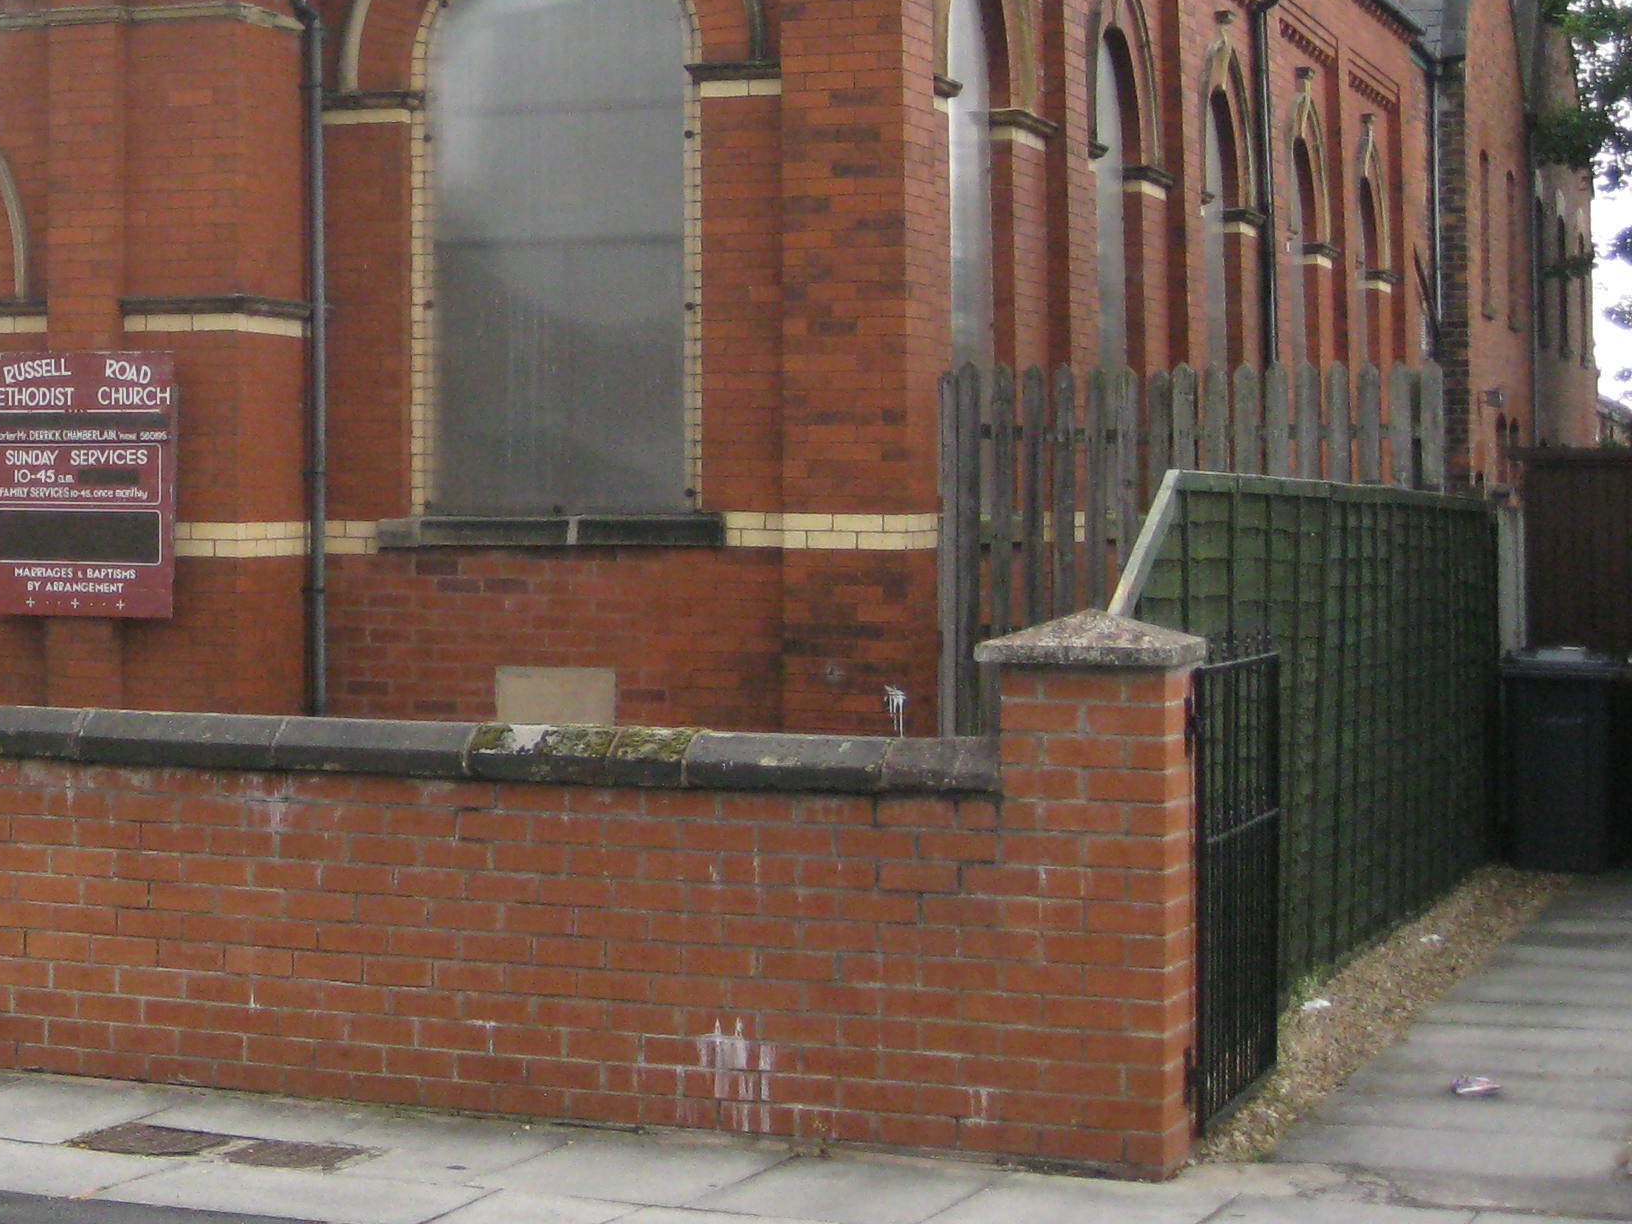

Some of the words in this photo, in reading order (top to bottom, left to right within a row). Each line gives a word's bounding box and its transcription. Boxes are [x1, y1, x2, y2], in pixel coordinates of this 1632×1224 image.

[3, 358, 72, 384] RUSSELL
[105, 359, 151, 384] ROAD
[97, 386, 171, 406] CHURCH
[29, 429, 61, 441] DERRICK
[62, 429, 117, 441] CHAMBERLAIN
[5, 449, 59, 466] SUNDAY
[70, 449, 148, 465] SERVICES
[14, 469, 55, 484] 10-45
[0, 487, 29, 498] FAMILY
[30, 487, 69, 498] SERVICES
[93, 490, 113, 498] once
[14, 567, 73, 578] MARRIAGES
[86, 568, 136, 579] BAPTISMS
[27, 581, 41, 591] BY
[45, 581, 124, 593] ARRANGEMENT
